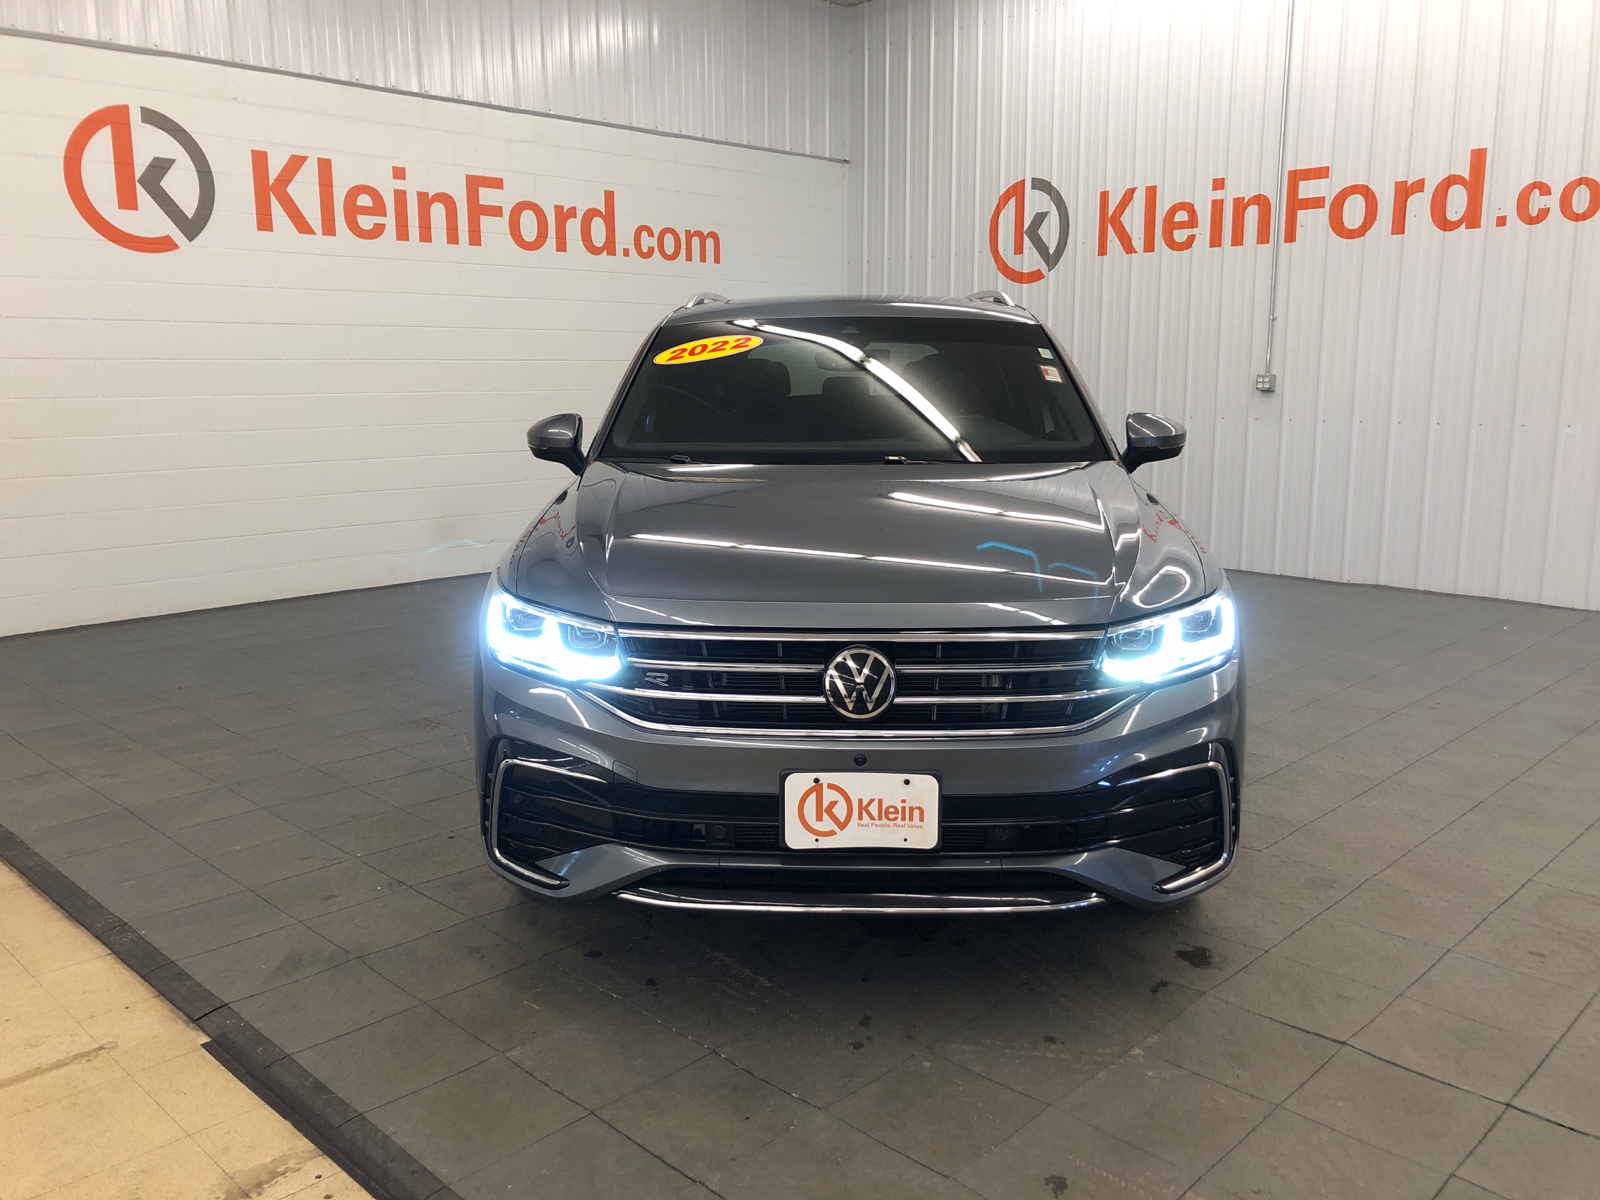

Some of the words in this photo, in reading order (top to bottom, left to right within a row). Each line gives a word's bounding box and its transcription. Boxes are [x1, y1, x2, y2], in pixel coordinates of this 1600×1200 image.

[251, 149, 722, 265] KleinFord.com
[665, 336, 752, 363] 2022
[857, 797, 925, 822] Klein
